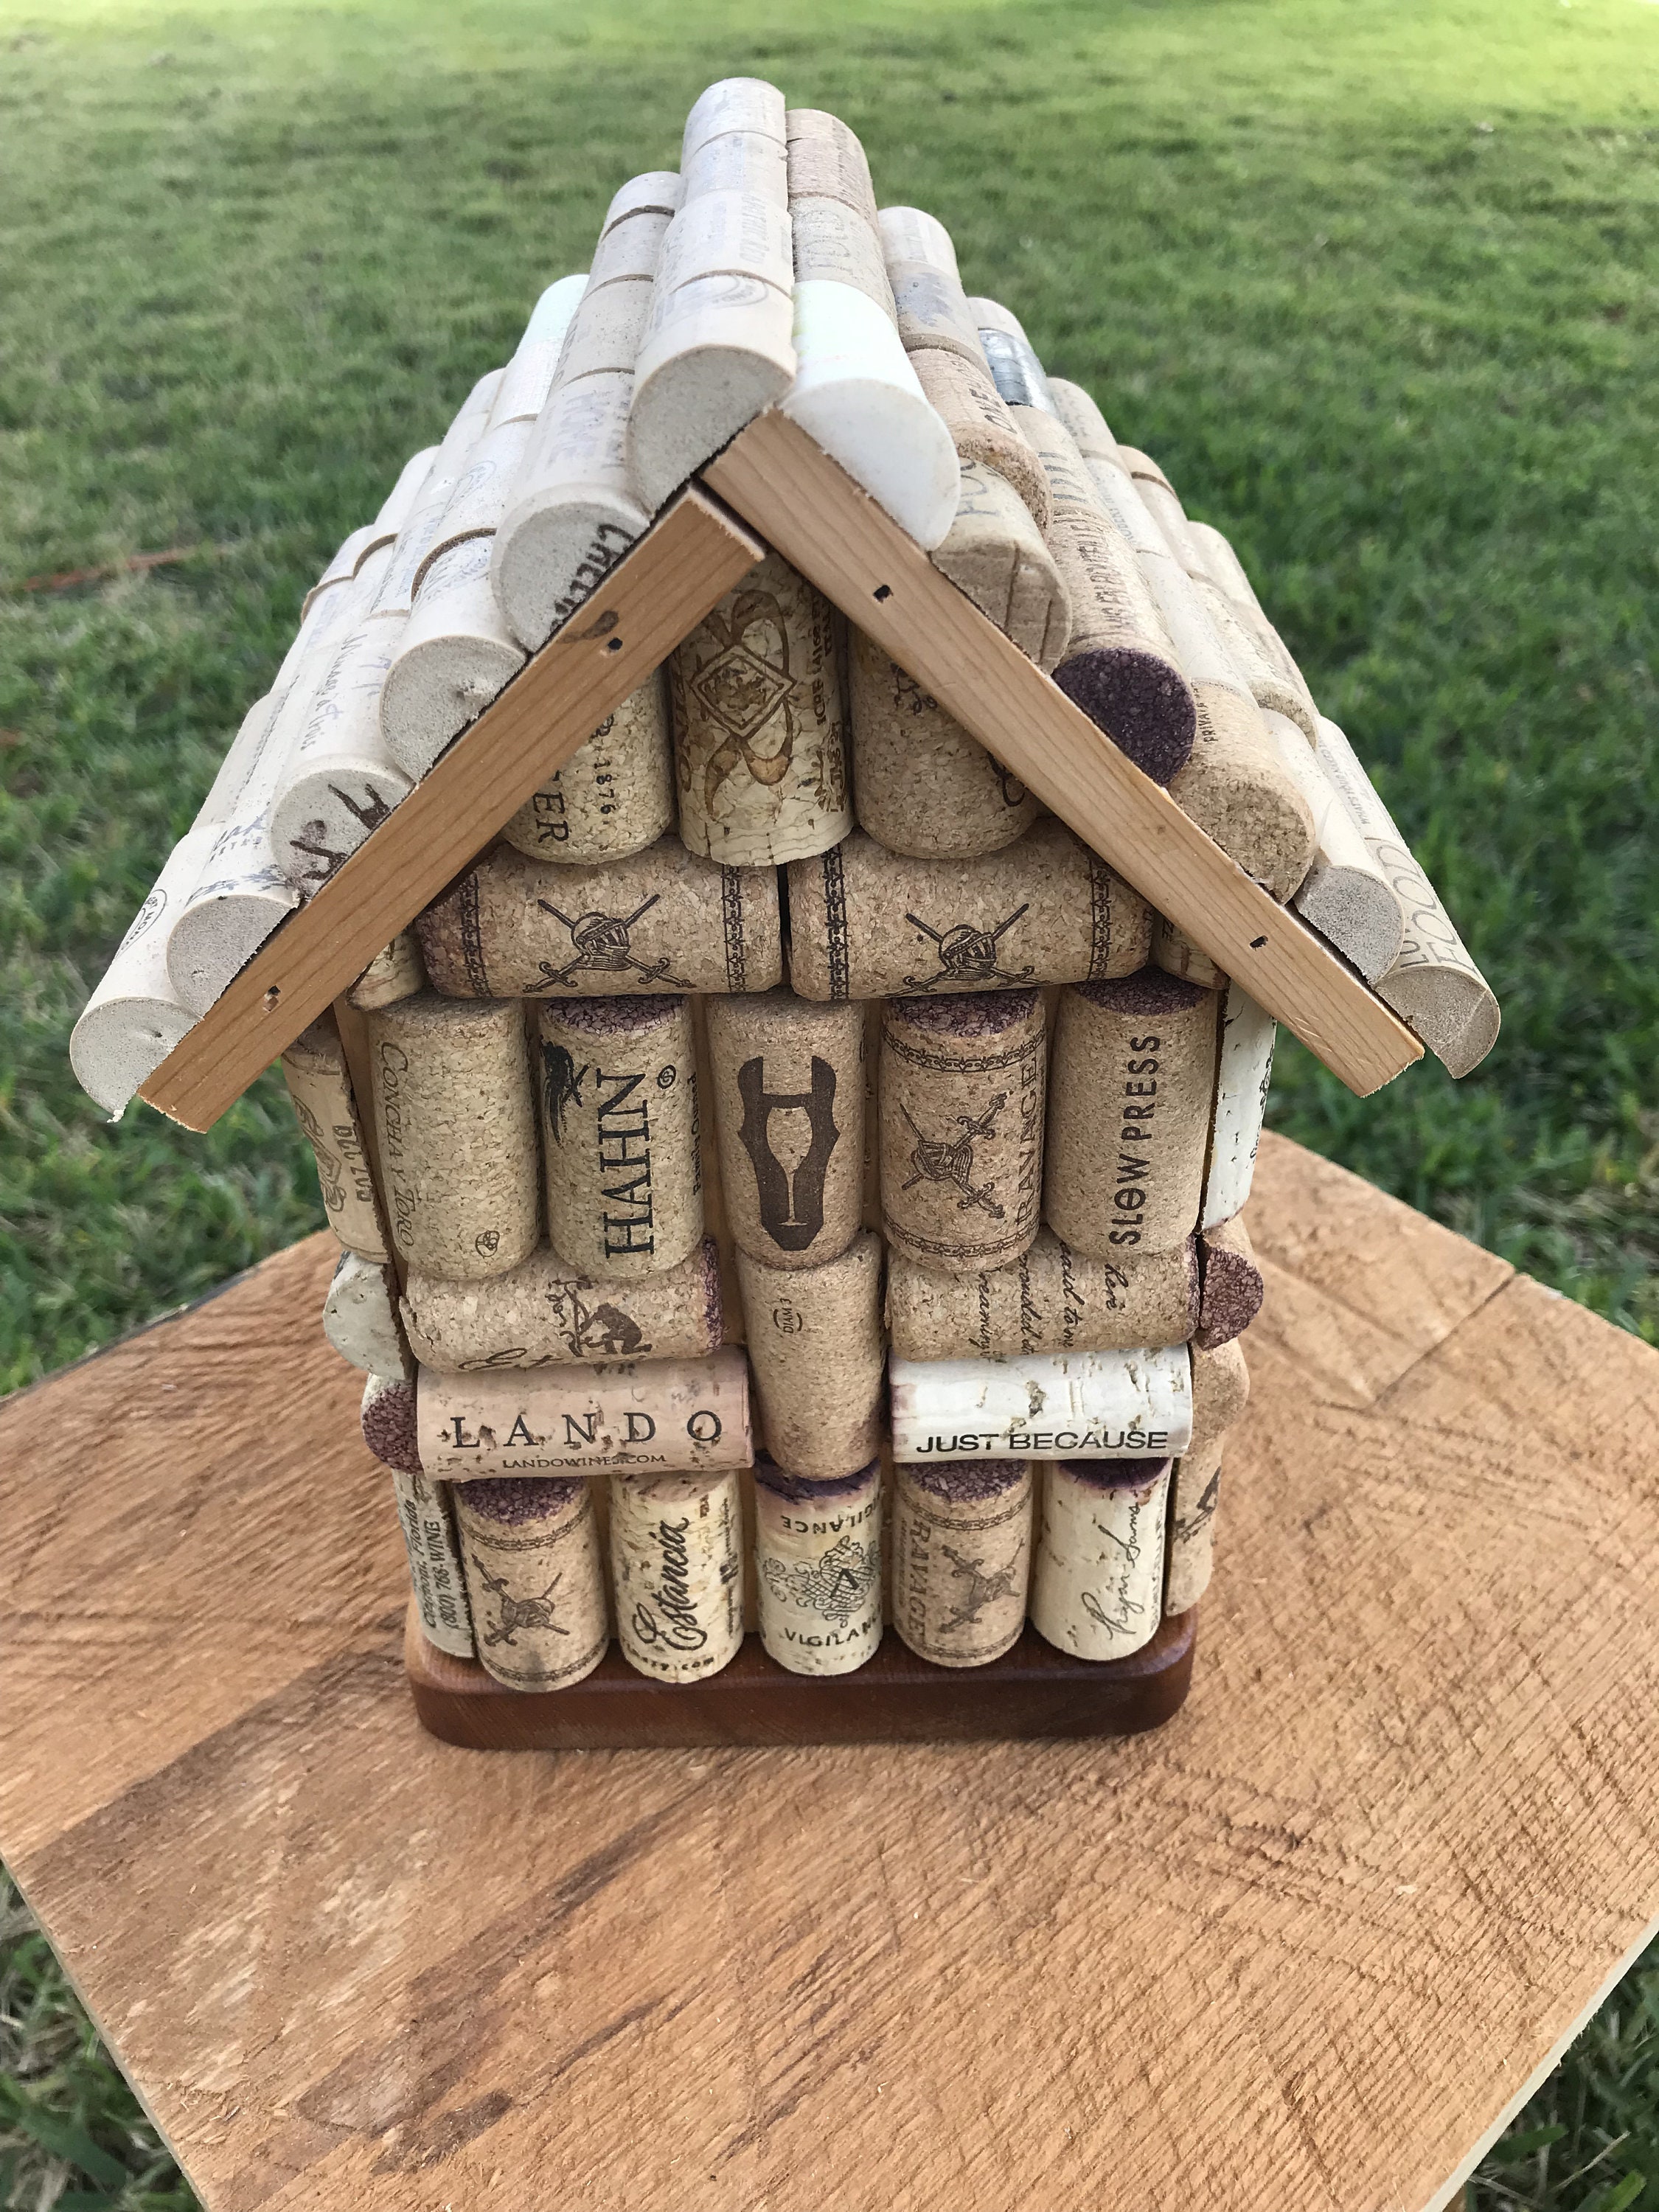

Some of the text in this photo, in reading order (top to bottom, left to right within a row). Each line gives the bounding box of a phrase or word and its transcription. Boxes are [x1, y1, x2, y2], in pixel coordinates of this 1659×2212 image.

[594, 759, 616, 815] 1876
[380, 1041, 409, 1159] CONCHA
[1108, 1035, 1161, 1246] SLOW PRESS
[394, 1184, 417, 1247] TORO
[782, 1307, 795, 1334] DIAM
[450, 1409, 723, 1449] LANDO
[916, 1431, 1169, 1453] JUST BECAUSE
[502, 1453, 667, 1469] LANDOWINES.COM
[404, 1499, 425, 1557] Florida
[632, 1517, 708, 1650] Estancia
[907, 1518, 932, 1644] RAVAGE
